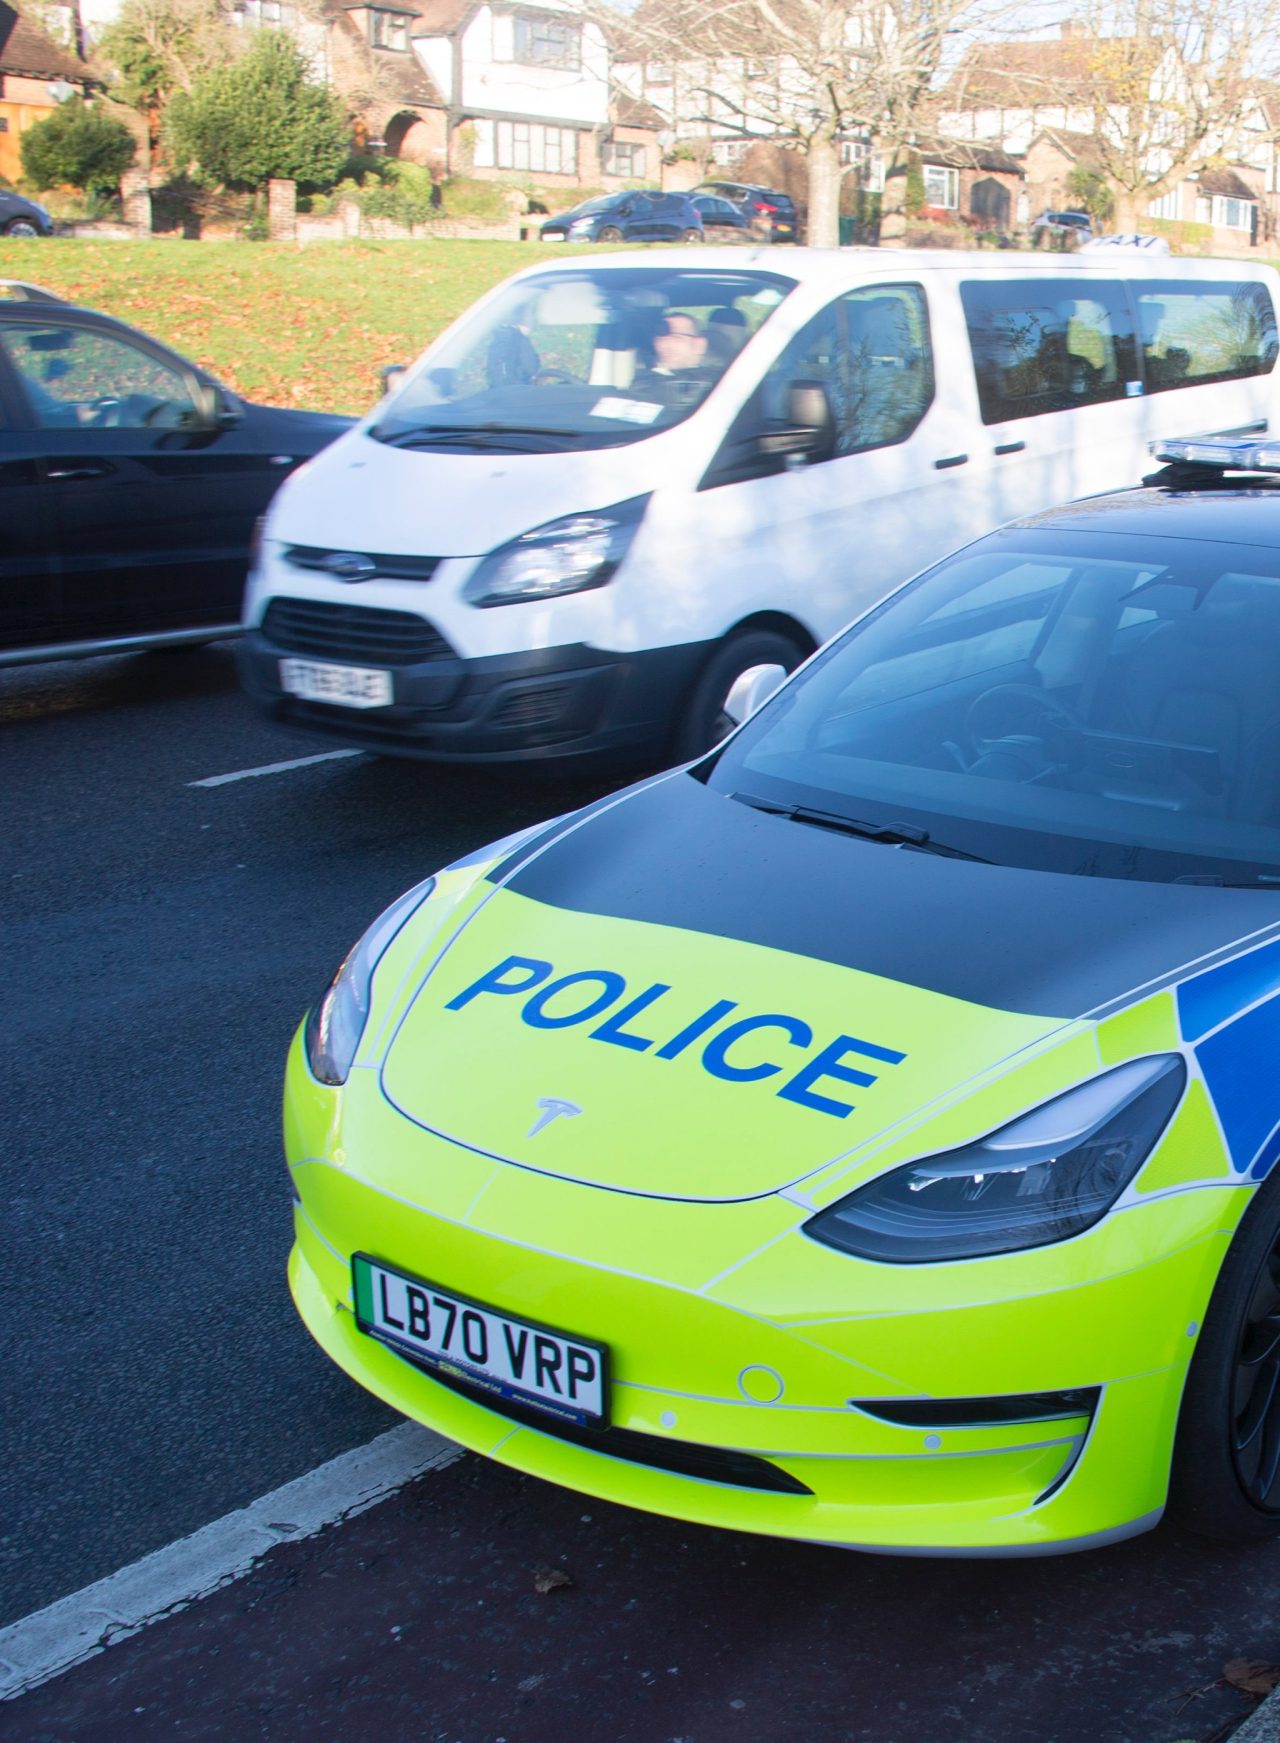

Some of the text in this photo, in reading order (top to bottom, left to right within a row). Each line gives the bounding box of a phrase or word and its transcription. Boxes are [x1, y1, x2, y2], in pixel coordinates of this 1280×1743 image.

[443, 955, 908, 1119] POLICE
[380, 1273, 596, 1400] LB70 VRP
